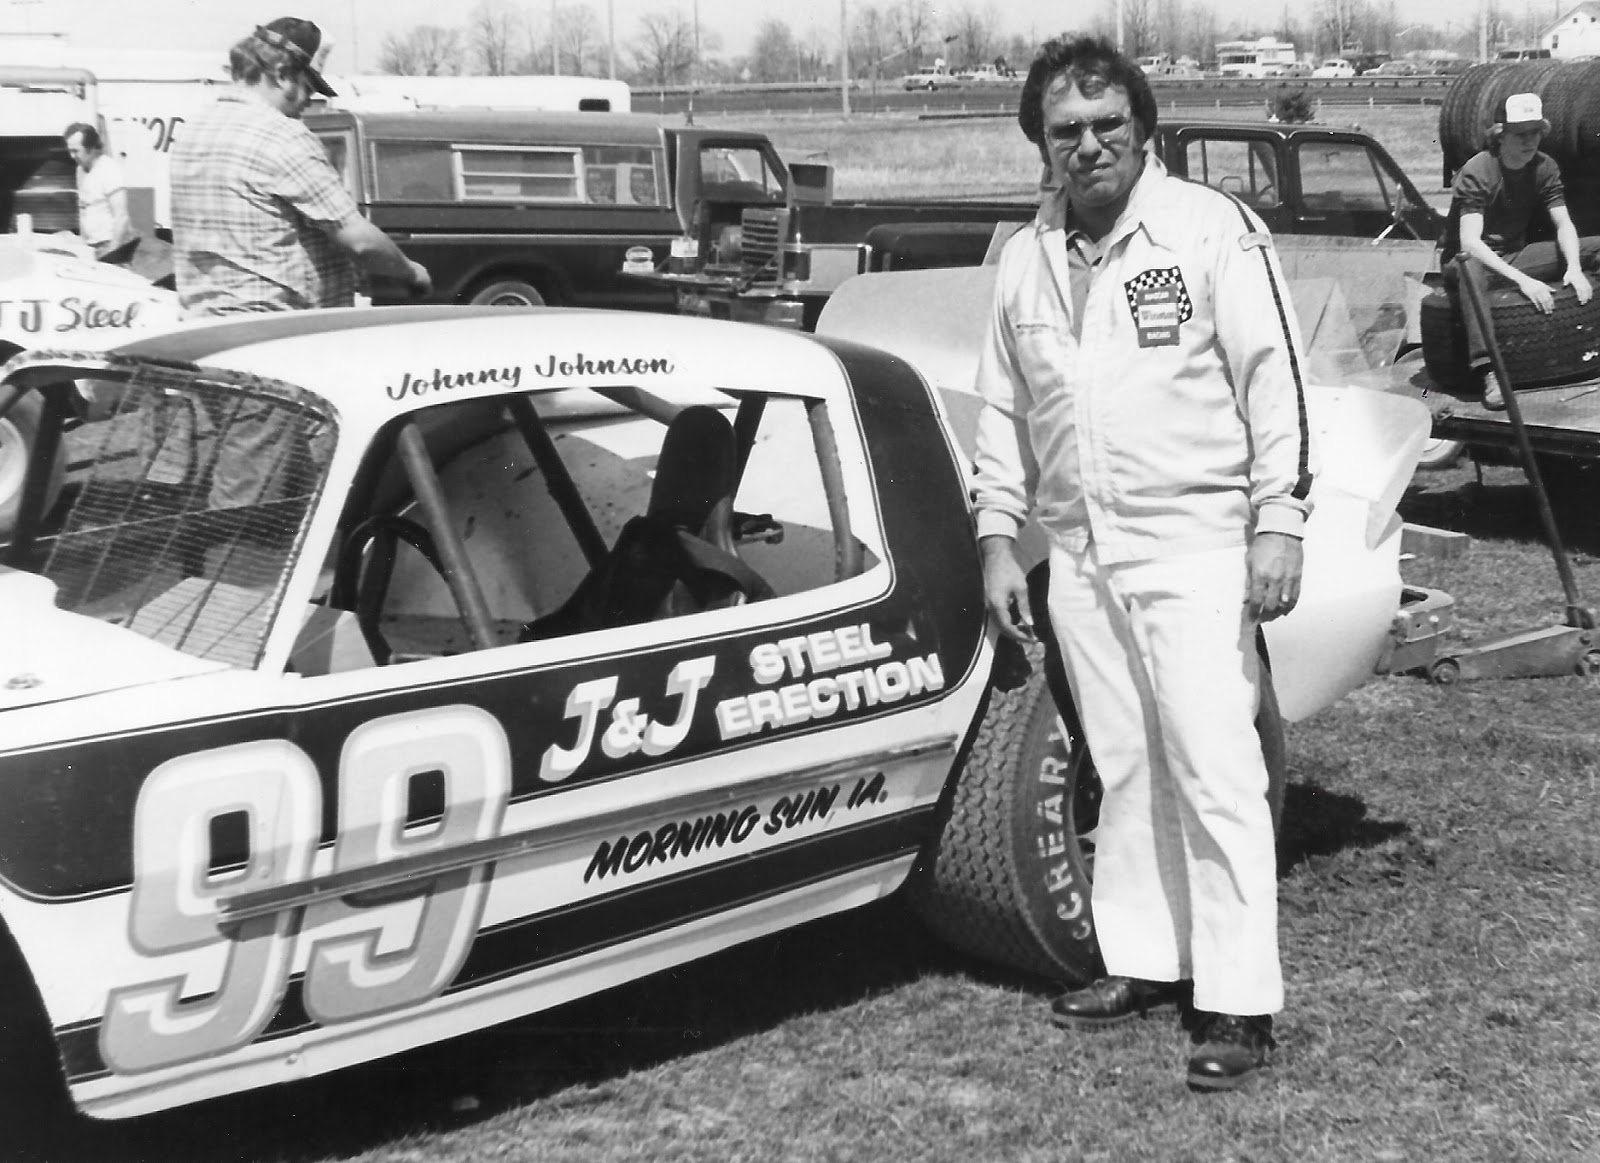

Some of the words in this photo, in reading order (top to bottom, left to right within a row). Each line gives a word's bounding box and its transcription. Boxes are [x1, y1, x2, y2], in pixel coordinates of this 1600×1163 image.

[54, 297, 140, 333] Steel
[386, 366, 521, 401] Johnny
[534, 353, 675, 378] Johnson
[749, 623, 892, 684] STEEL
[539, 655, 716, 782] J&J
[715, 653, 945, 740] ERECTION
[583, 805, 761, 884] MORNING
[98, 703, 513, 1076] 99
